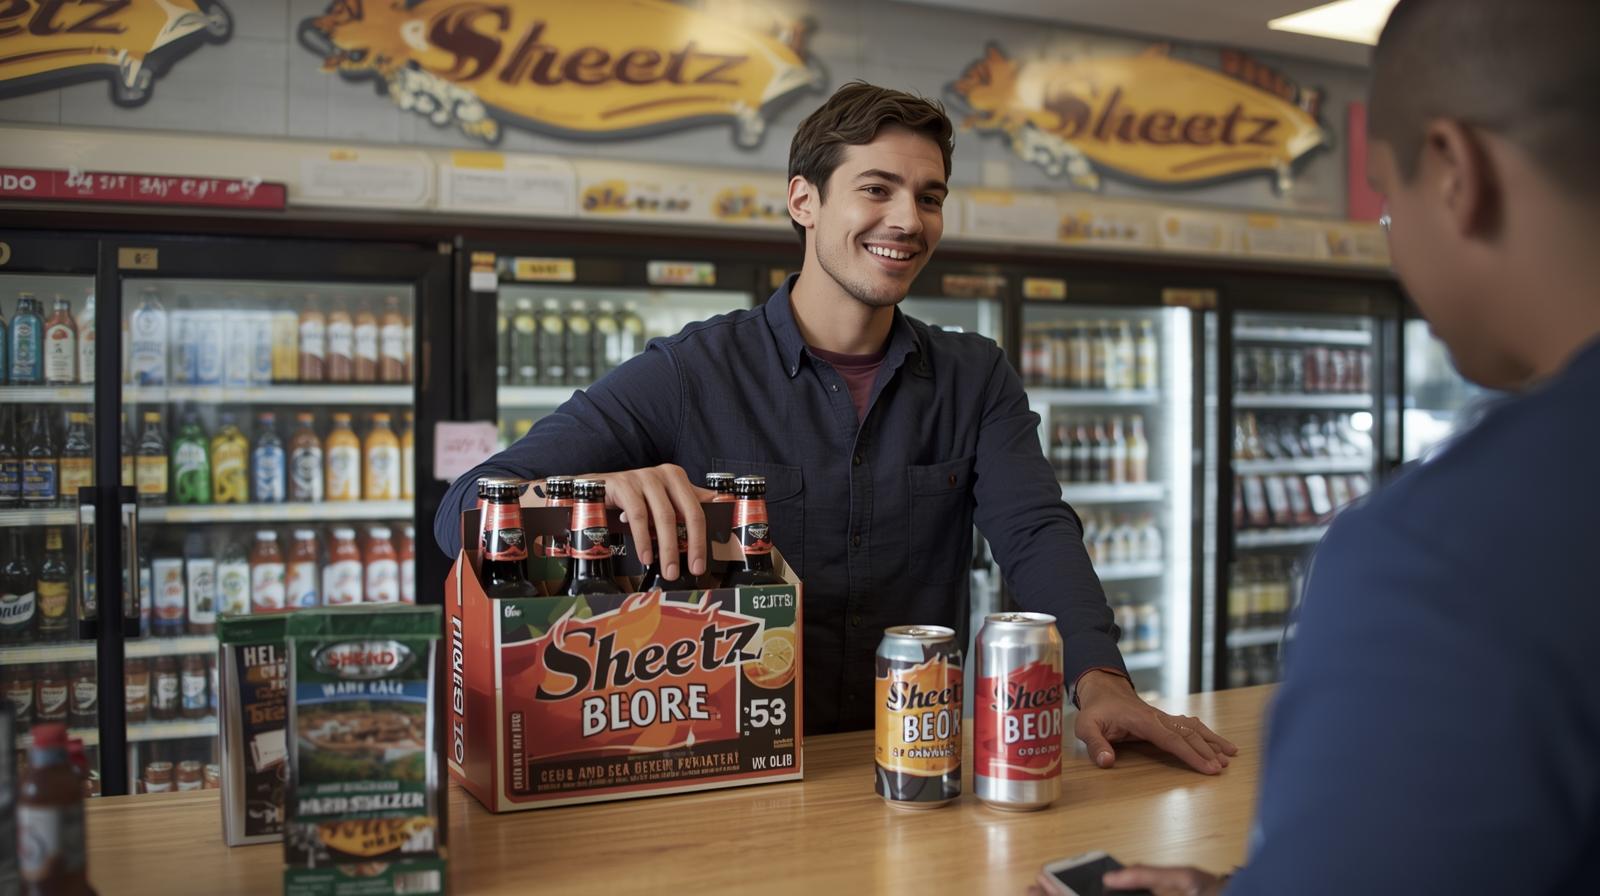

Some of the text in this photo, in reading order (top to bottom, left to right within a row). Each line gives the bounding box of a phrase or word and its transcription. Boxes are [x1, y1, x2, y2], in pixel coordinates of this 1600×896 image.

[425, 3, 749, 87] Sheetz
[1042, 84, 1279, 147] Sheetz
[0, 174, 37, 190] DO
[535, 622, 763, 701] Sheetz
[582, 684, 710, 738] BLORE
[1004, 708, 1062, 744] BEOR
